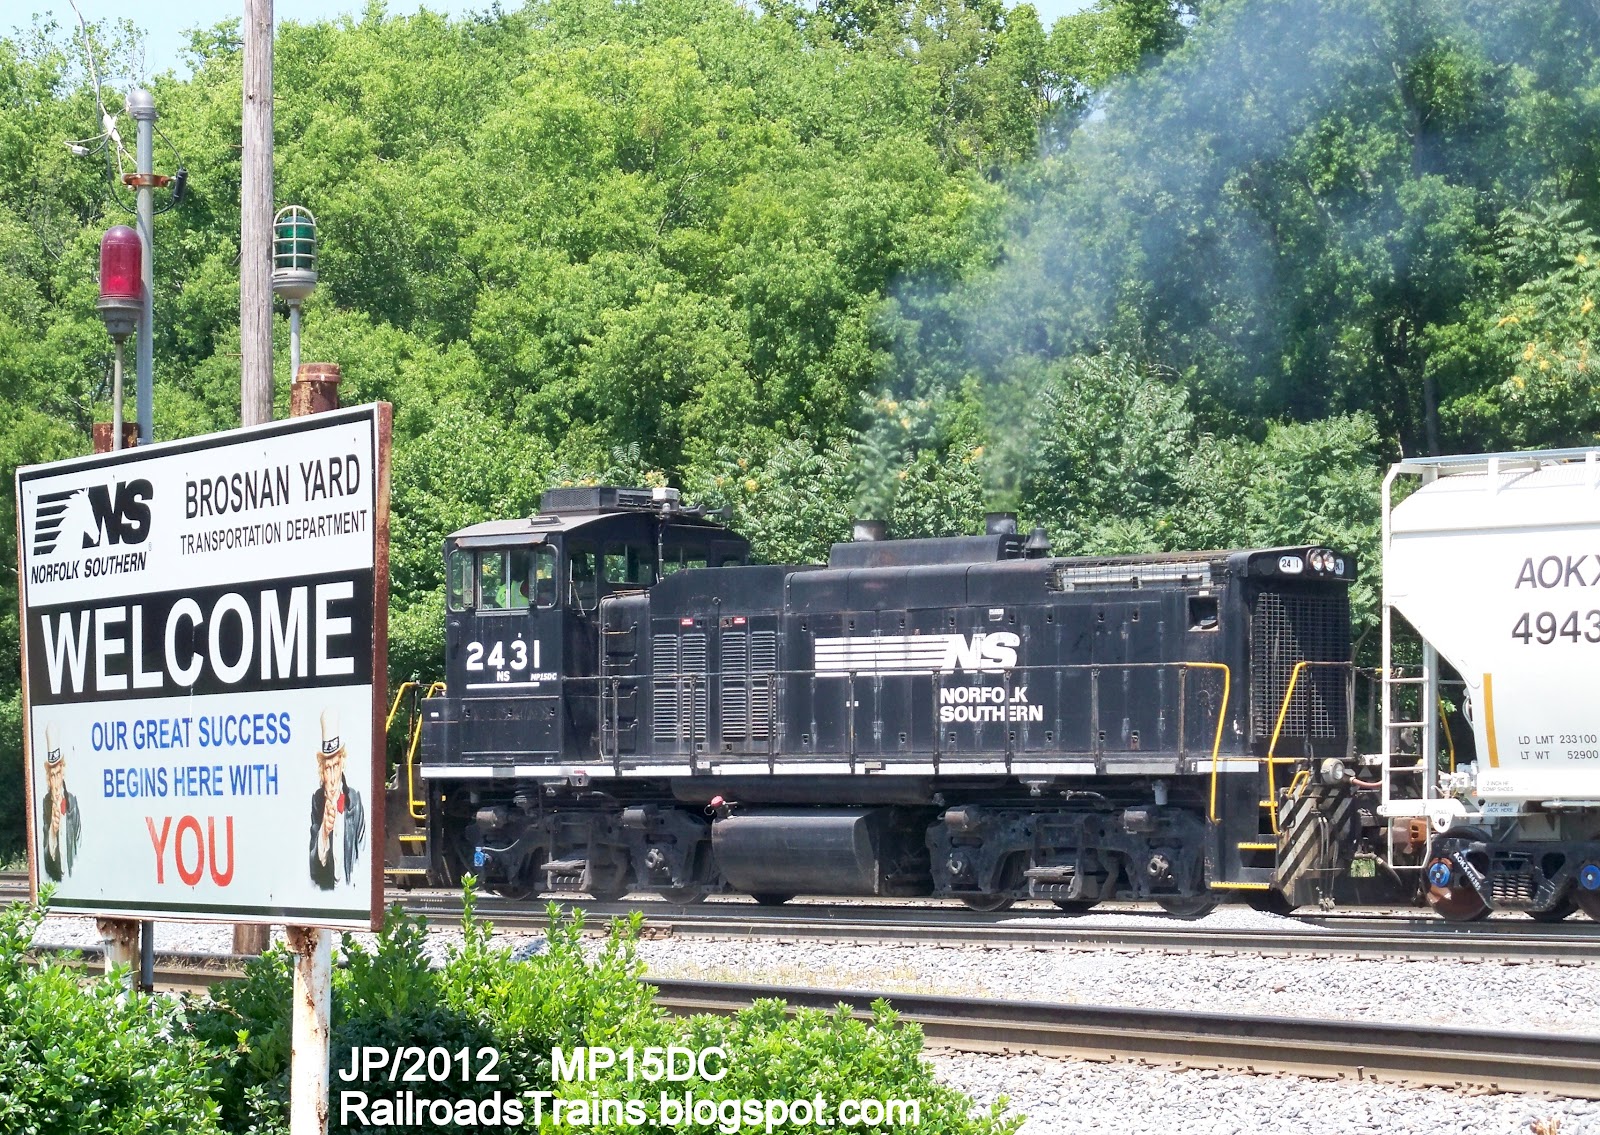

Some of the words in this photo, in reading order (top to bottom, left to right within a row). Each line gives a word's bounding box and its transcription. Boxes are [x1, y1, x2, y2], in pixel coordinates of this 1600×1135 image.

[186, 465, 290, 519] BROSNAN
[300, 454, 361, 501] YARD
[180, 520, 281, 555] TRANSPORTATION
[286, 510, 367, 541] DEPARTMENT
[31, 559, 79, 585] NORFOLK
[84, 551, 147, 580] SOUTHERN
[41, 580, 355, 695] WELCOME
[1511, 609, 1600, 645] 4943
[466, 640, 540, 670] 2431
[939, 632, 1021, 674] NS
[496, 671, 511, 682] NS
[530, 672, 558, 682] MP15DC
[939, 705, 1044, 722] SOUTHERN
[91, 721, 128, 751] OUR
[133, 717, 193, 750] GREAT
[198, 712, 291, 747] SUCCESS
[1518, 735, 1531, 745] LD
[1535, 735, 1554, 745] LMT
[1559, 734, 1598, 744] 233100
[1191, 762, 1197, 772] F
[1520, 751, 1530, 760] LT
[1535, 751, 1550, 760] WT
[1567, 750, 1599, 760] 52900
[103, 766, 168, 798] BEGINS
[173, 765, 223, 797] HERE
[230, 764, 279, 796] WITH
[144, 815, 234, 887] YOU
